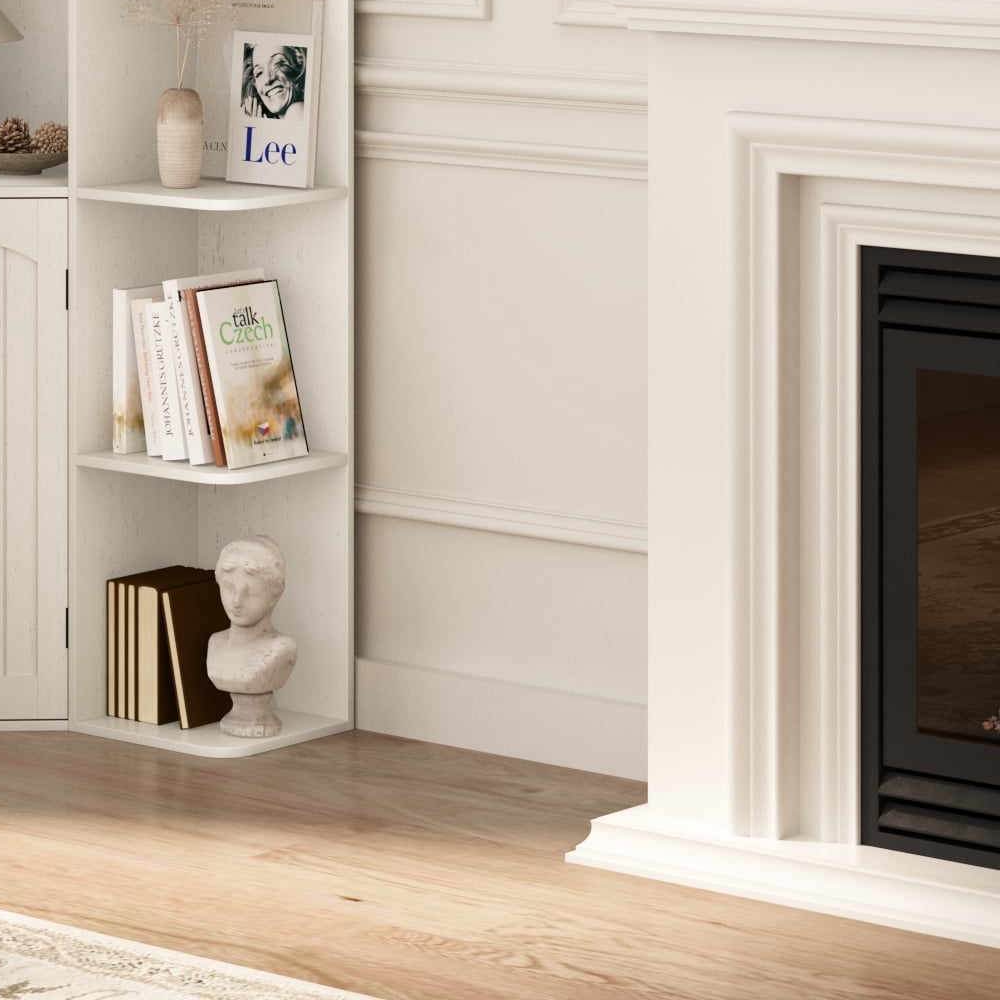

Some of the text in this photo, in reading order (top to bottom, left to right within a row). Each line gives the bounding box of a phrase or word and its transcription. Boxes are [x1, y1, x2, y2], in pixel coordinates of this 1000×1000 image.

[202, 140, 209, 151] A
[242, 125, 297, 166] Lee
[232, 306, 260, 328] talk
[219, 316, 274, 346] Czech
